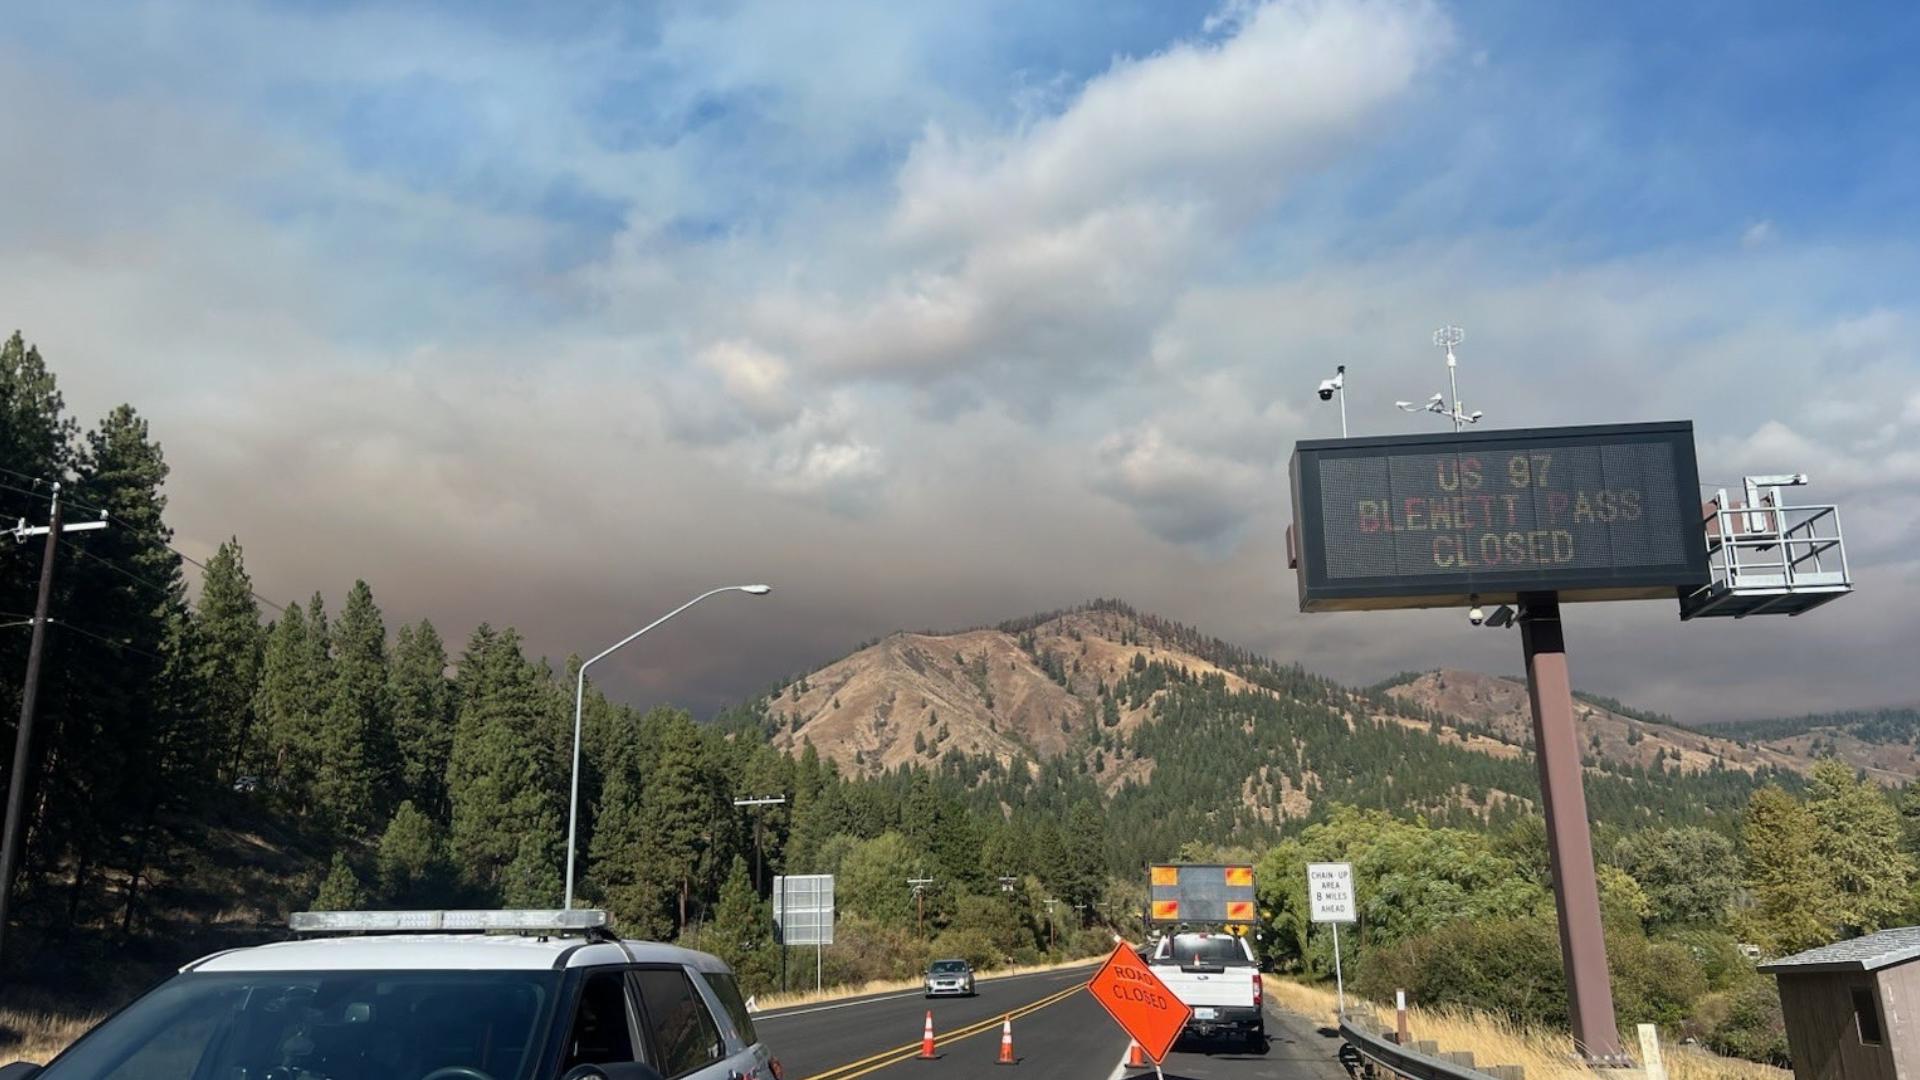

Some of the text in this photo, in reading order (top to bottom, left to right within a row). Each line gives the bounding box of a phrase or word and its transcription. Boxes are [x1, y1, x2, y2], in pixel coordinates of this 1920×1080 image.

[1437, 455, 1552, 491] US 97
[1360, 489, 1642, 532] BLEWETT PASS
[1432, 530, 1574, 567] CLOSED
[1321, 881, 1340, 889] AREA
[1325, 892, 1347, 901] MILES
[1321, 904, 1345, 913] AHEAD
[1114, 966, 1153, 986] ROAD
[1113, 984, 1167, 1010] CLOSED
